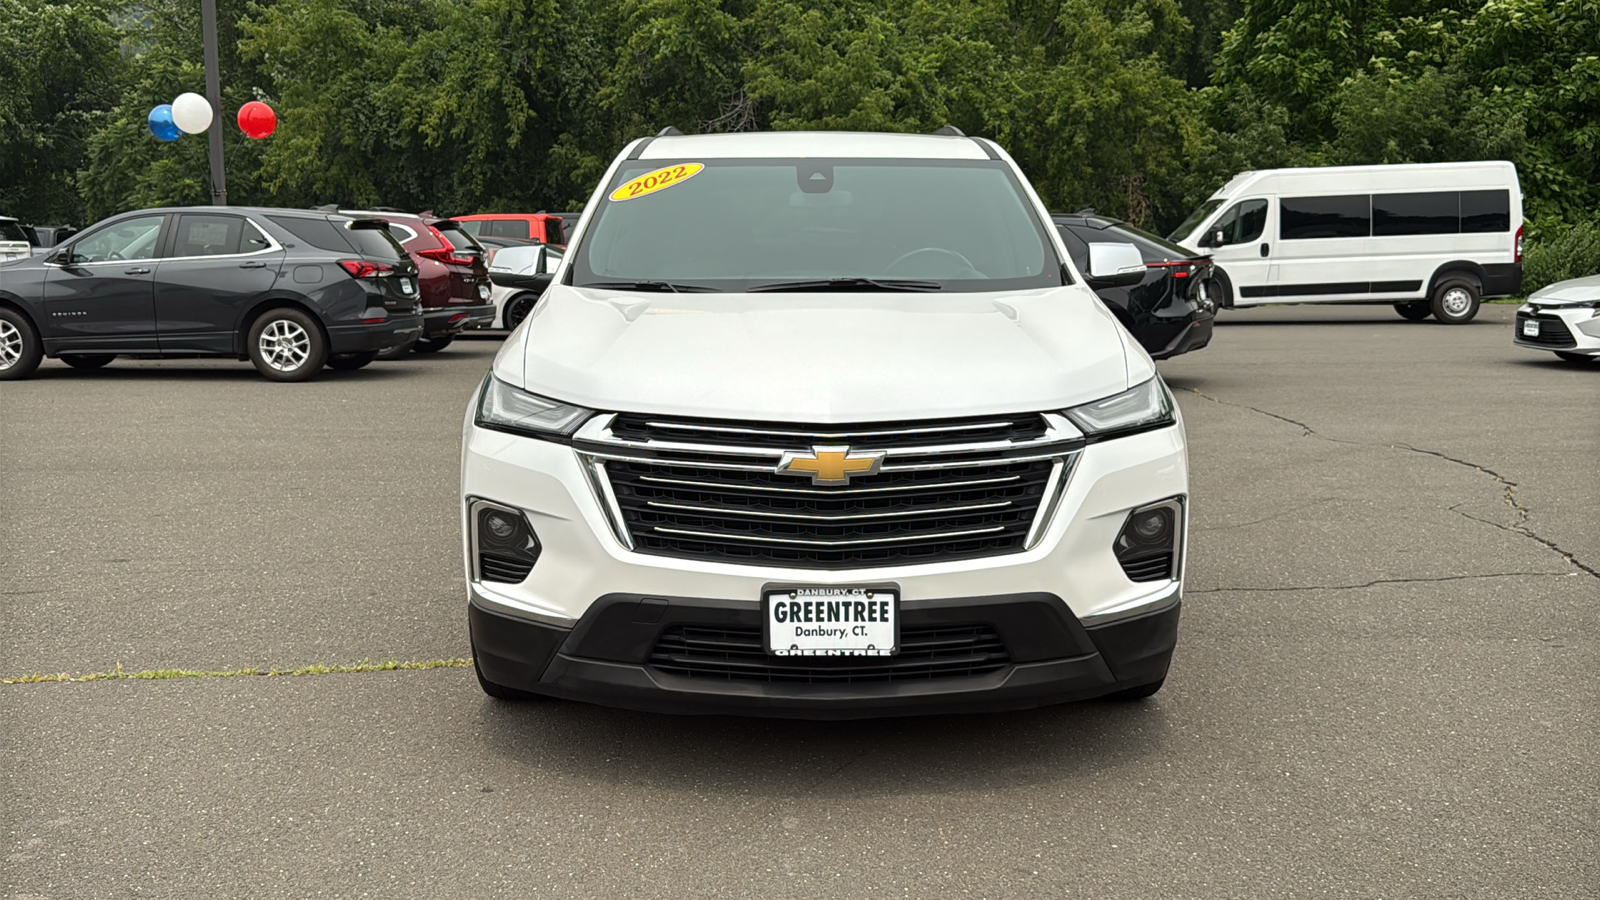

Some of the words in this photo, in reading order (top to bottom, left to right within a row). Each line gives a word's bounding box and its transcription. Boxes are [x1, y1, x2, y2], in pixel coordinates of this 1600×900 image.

[628, 166, 688, 197] 2022
[774, 601, 889, 623] GREENTREE
[795, 625, 849, 640] Danbury,
[852, 626, 868, 637] CT.
